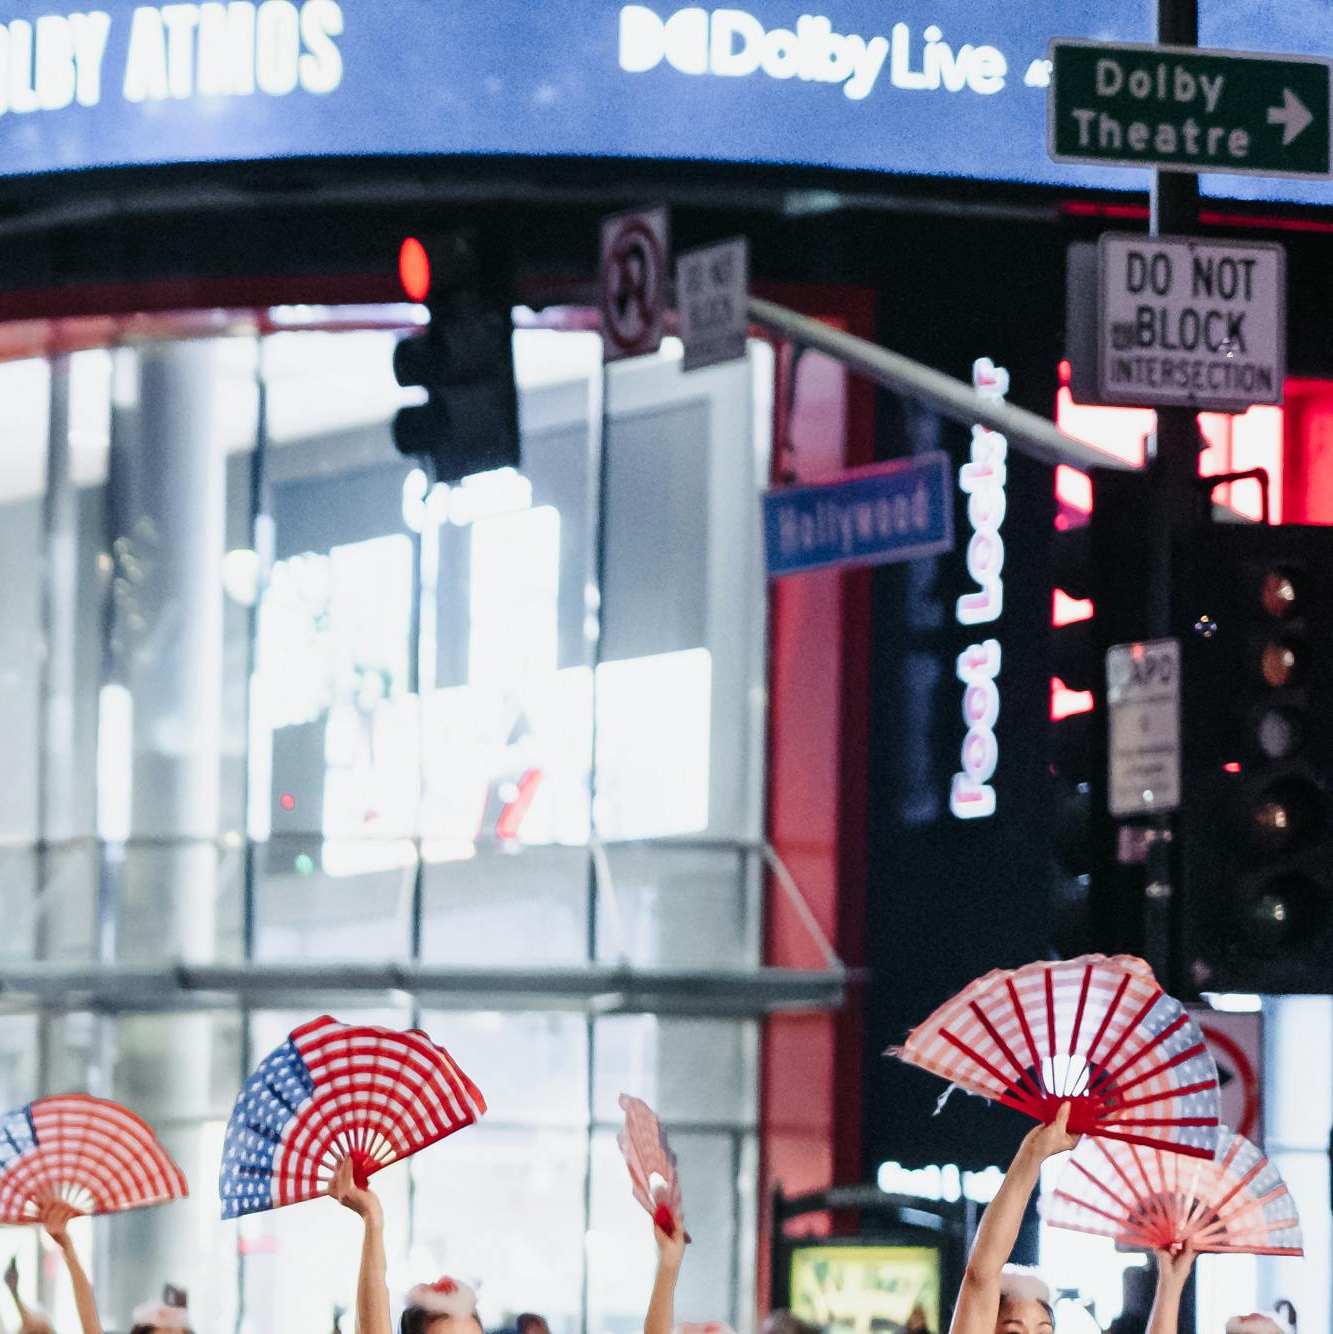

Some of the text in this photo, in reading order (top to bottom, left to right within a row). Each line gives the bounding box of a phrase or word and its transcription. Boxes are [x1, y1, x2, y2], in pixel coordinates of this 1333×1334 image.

[124, 0, 344, 101] ATMOS
[710, 8, 1008, 100] Dolby Live
[1096, 58, 1225, 114] Dolby
[1071, 106, 1251, 159] Theatre
[1125, 251, 1256, 302] DO NOT
[1136, 304, 1252, 354] BLOCK
[1110, 355, 1273, 393] INTERSECTION
[779, 477, 930, 553] Hollywood
[950, 356, 1010, 820] Foot Lockr
